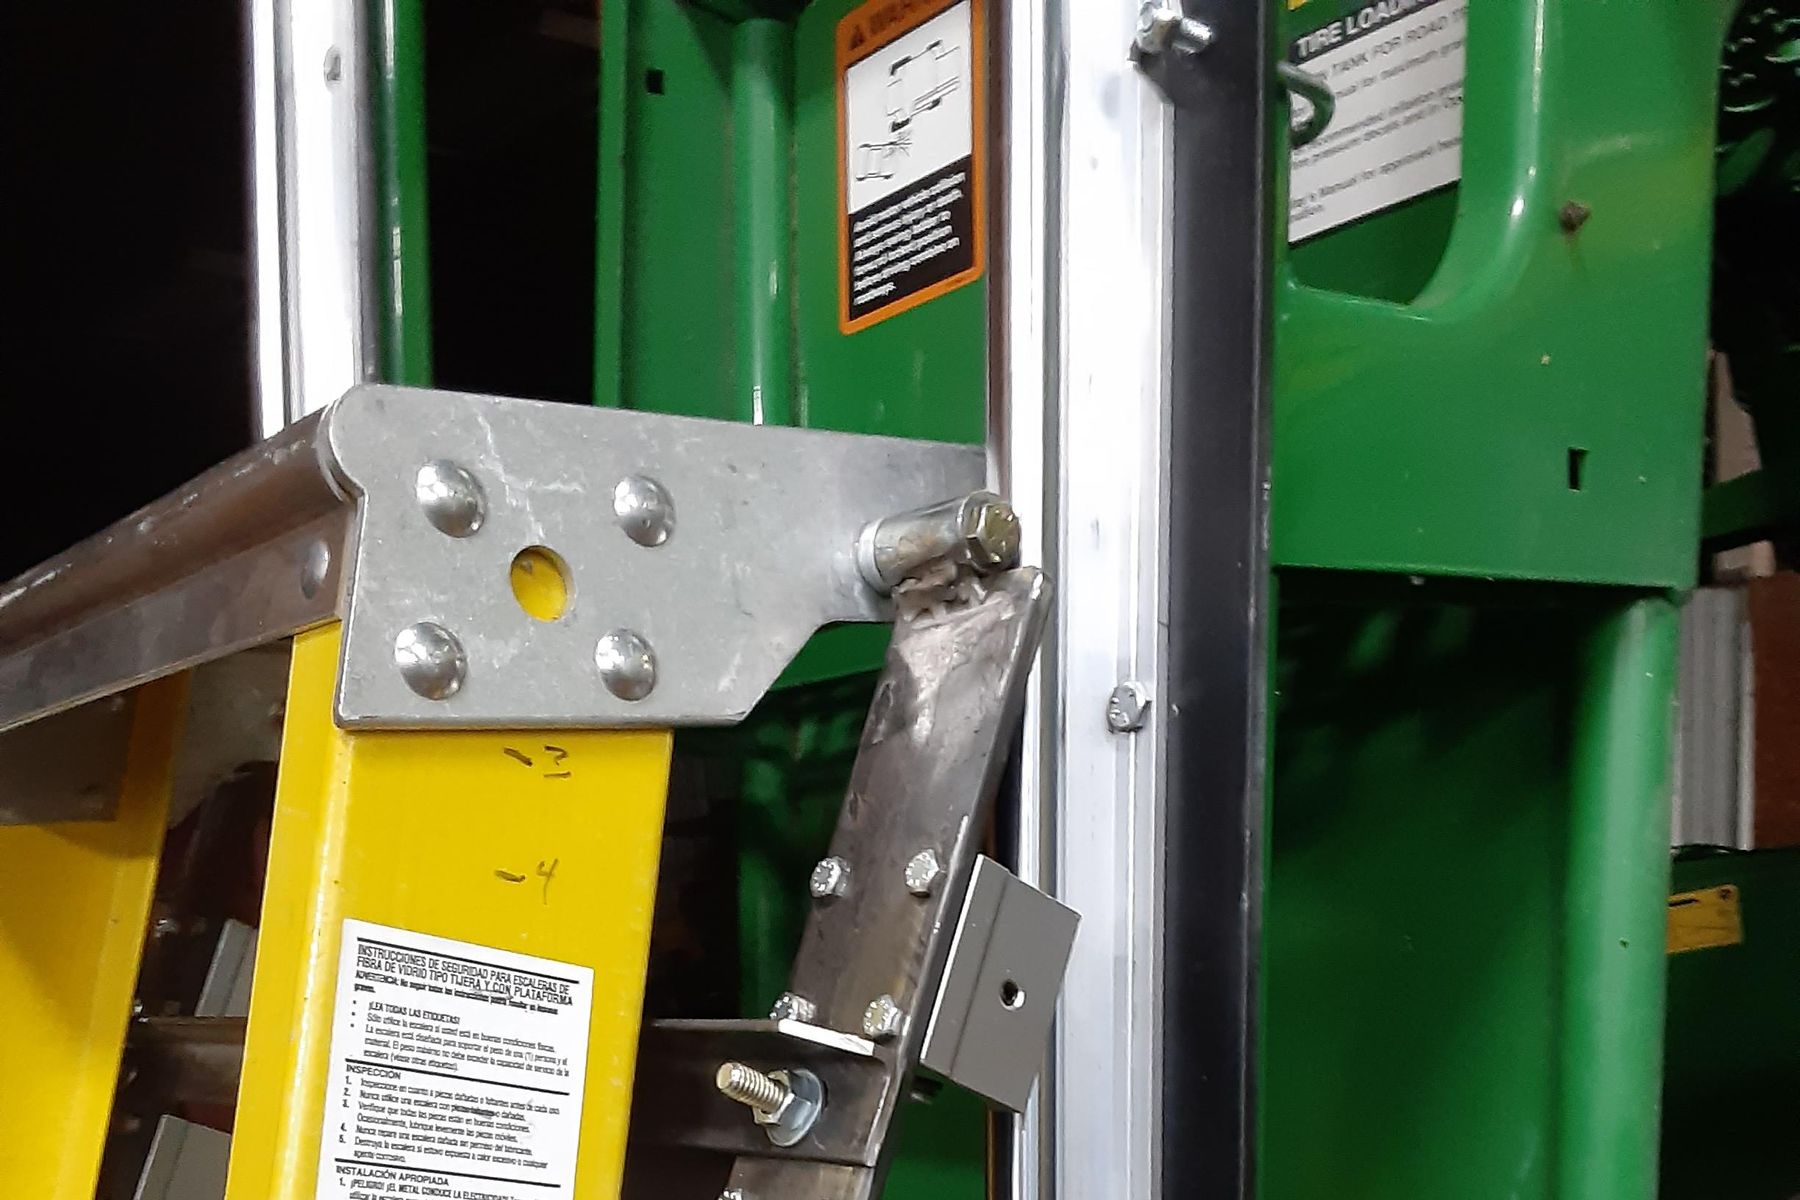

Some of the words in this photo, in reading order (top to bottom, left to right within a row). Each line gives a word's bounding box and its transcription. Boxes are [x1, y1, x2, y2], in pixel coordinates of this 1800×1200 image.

[1296, 21, 1342, 57] TIRE
[356, 955, 381, 970] FIBRA
[398, 964, 426, 978] VIDRIO
[429, 969, 447, 982] TIPO
[451, 973, 480, 989] TIJERA
[513, 986, 572, 1006] PLATAFORMA
[357, 943, 426, 967] INSTRUCCIONES
[441, 960, 488, 978] SEGURIDAD
[489, 969, 511, 983] PARA
[512, 974, 557, 992] ESCALERAS
[335, 1164, 396, 1179] INSTALACIÓN
[398, 1172, 449, 1186] APROPIADA
